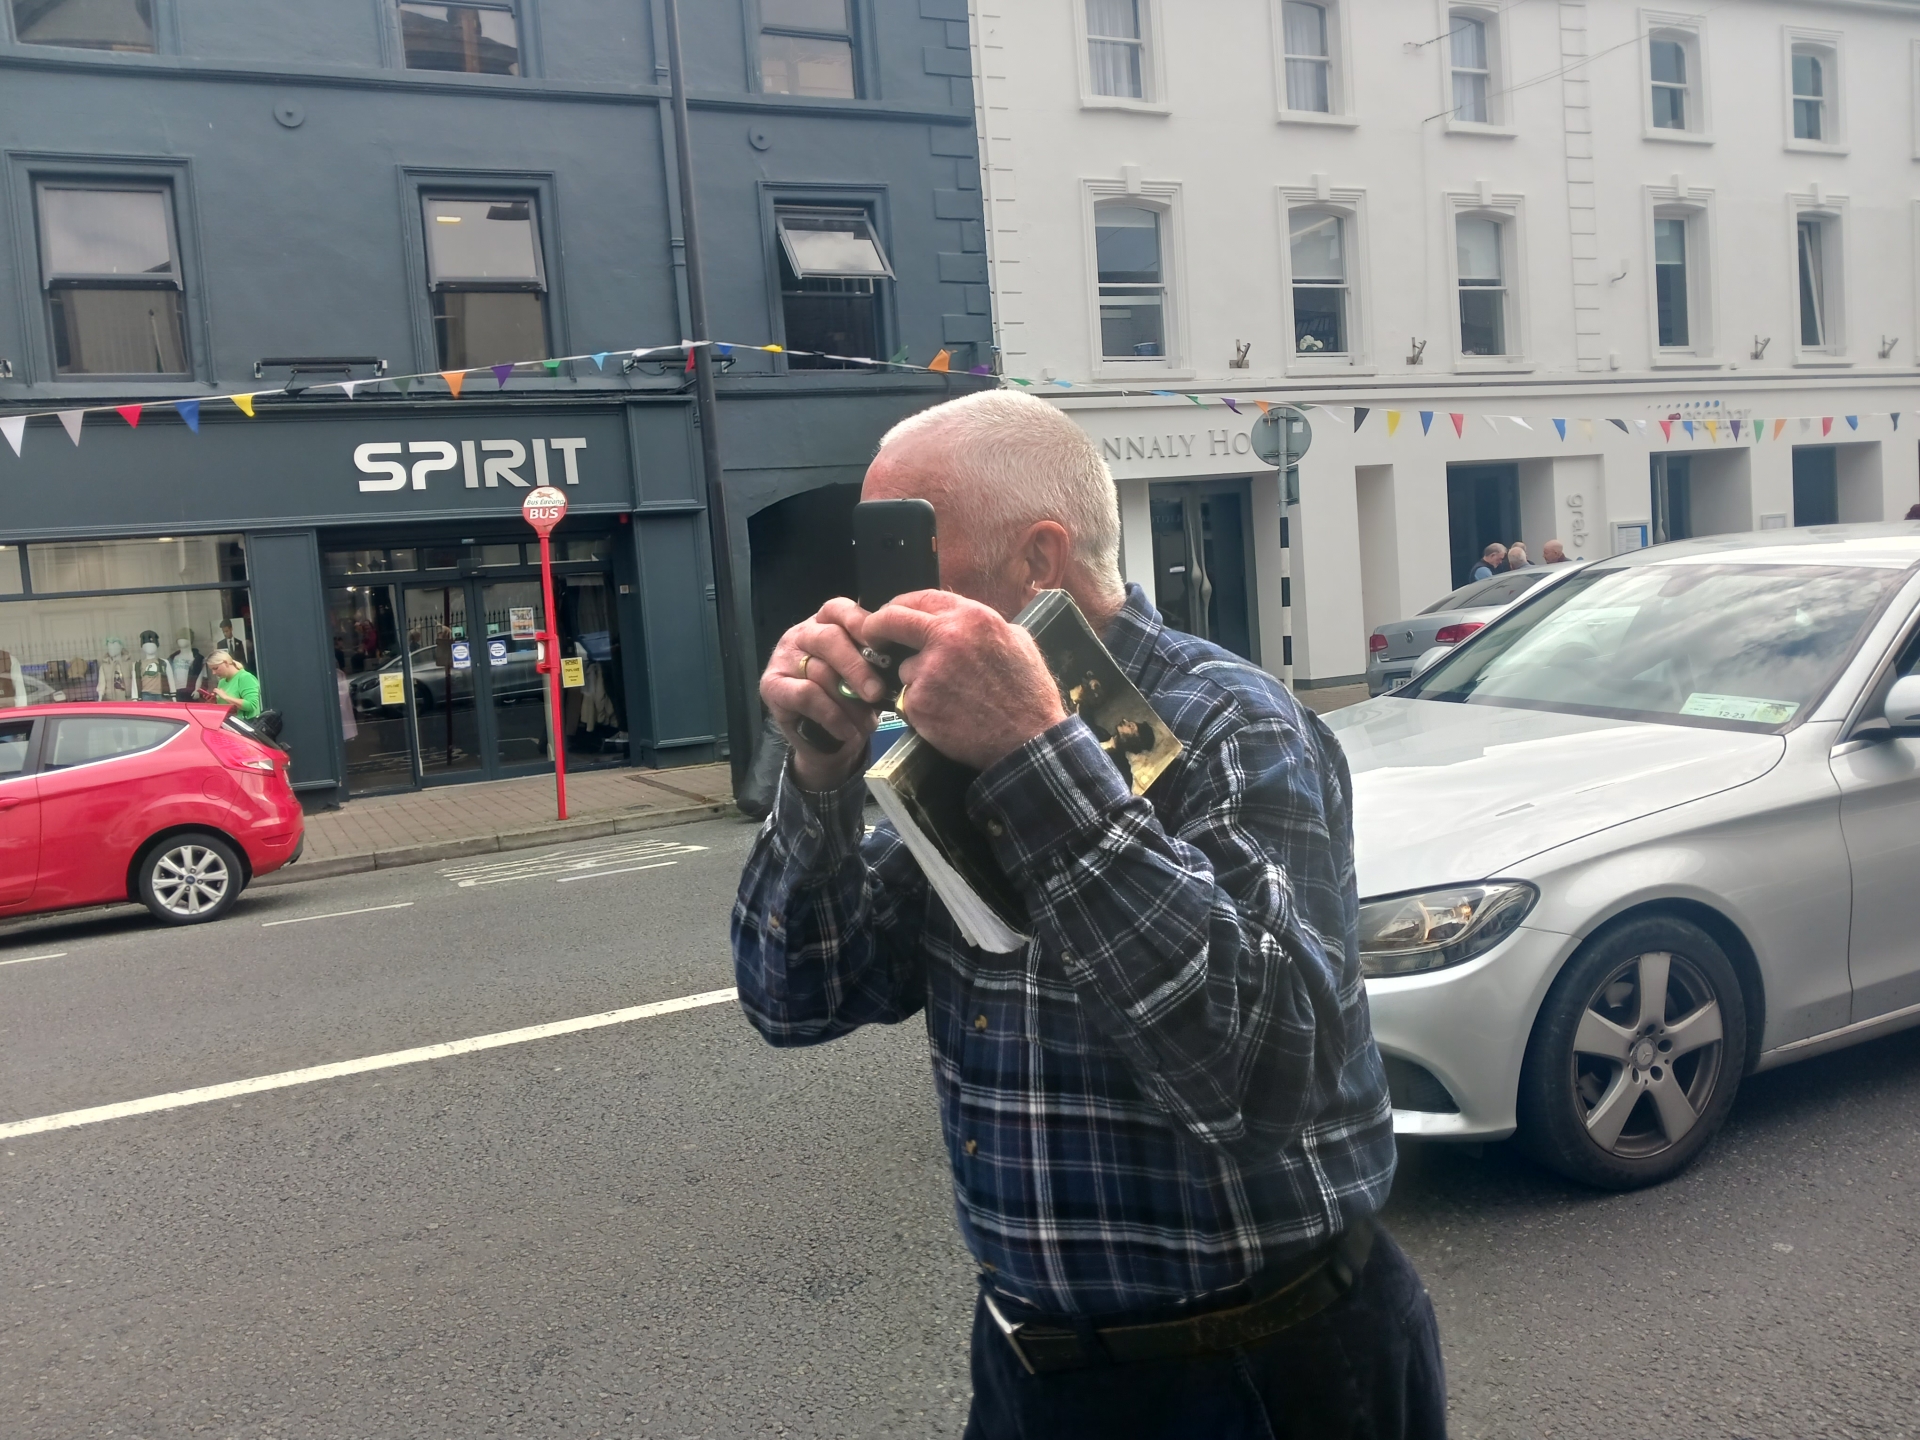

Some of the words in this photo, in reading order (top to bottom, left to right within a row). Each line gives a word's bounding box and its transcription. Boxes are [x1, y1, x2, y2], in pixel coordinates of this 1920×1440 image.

[353, 437, 587, 492] SPIRIT
[1102, 434, 1196, 460] NNALY
[1207, 429, 1251, 456] HO
[529, 507, 559, 520] BUS
[1566, 493, 1589, 548] grab
